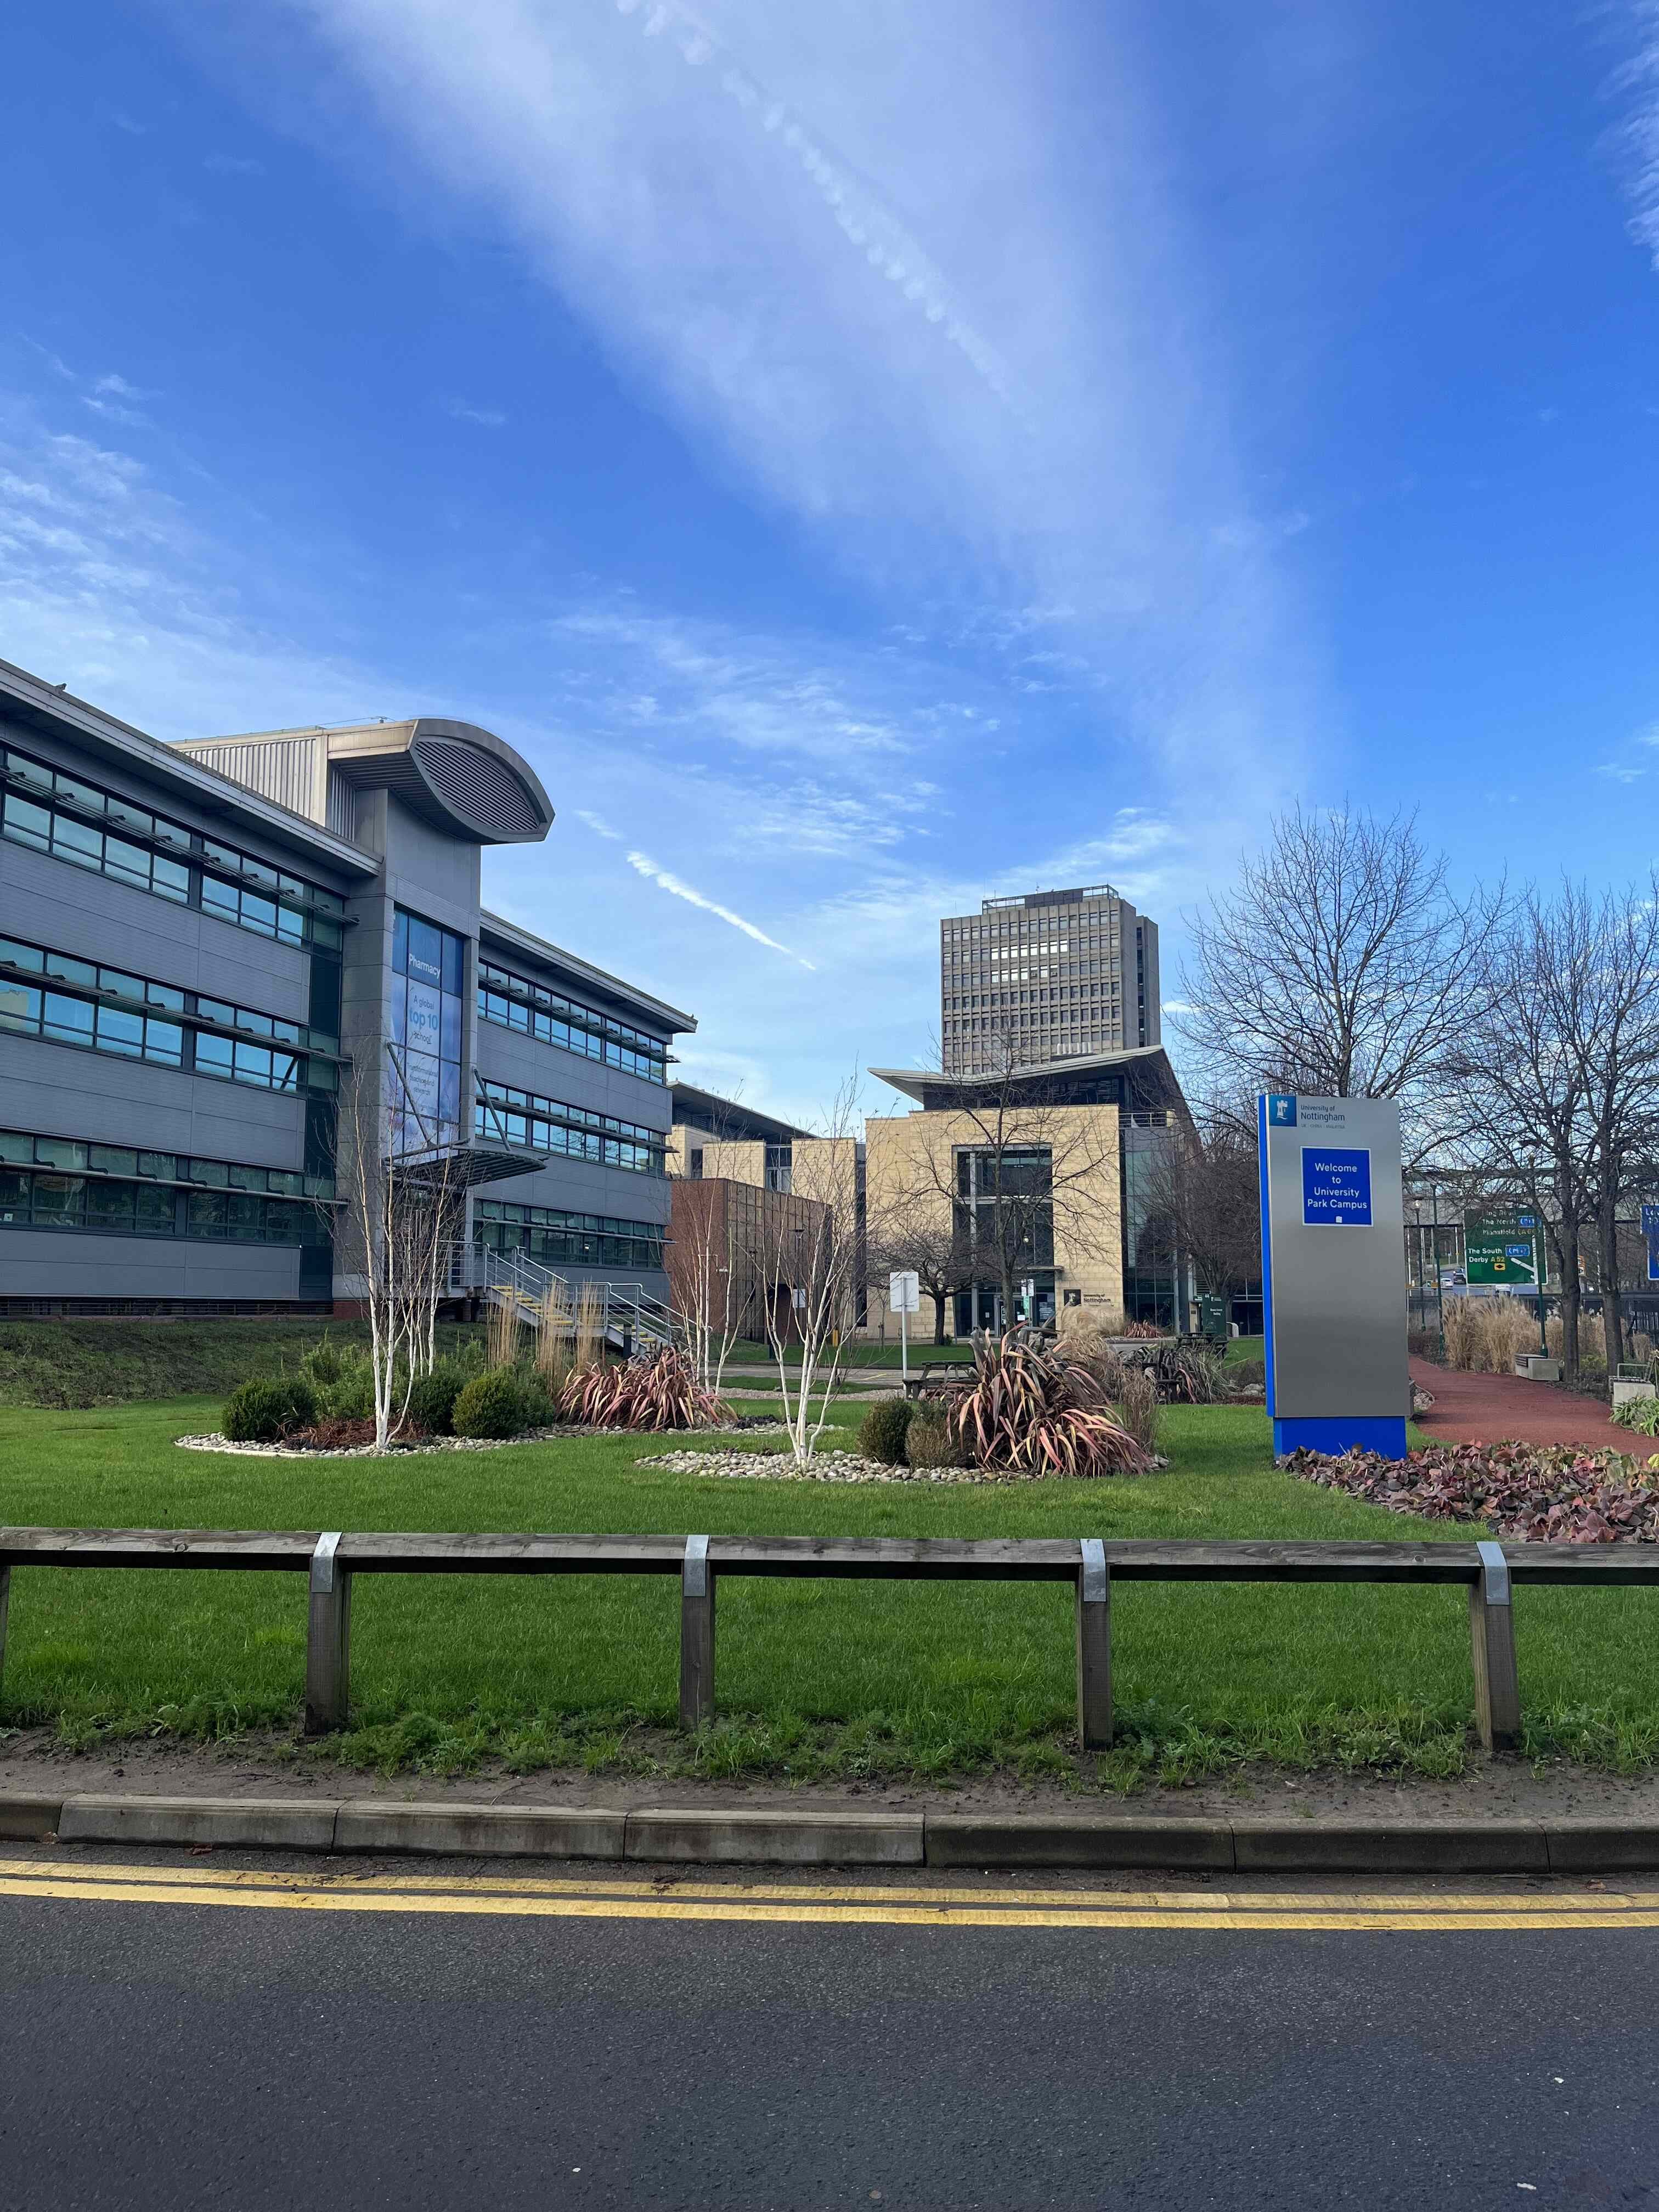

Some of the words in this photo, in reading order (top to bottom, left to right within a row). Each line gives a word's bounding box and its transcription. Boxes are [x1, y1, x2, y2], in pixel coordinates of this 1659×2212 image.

[409, 953, 441, 979] Pharmacy
[414, 995, 418, 1003] A
[419, 997, 435, 1010] global
[409, 1007, 426, 1030] top
[427, 1013, 438, 1031] 10
[414, 1031, 432, 1044] school
[1301, 1113, 1345, 1122] Nottingham
[1314, 1163, 1358, 1172] Welcome
[1314, 1187, 1359, 1198] University
[1307, 1199, 1328, 1207] Park
[1330, 1199, 1367, 1210] Campus
